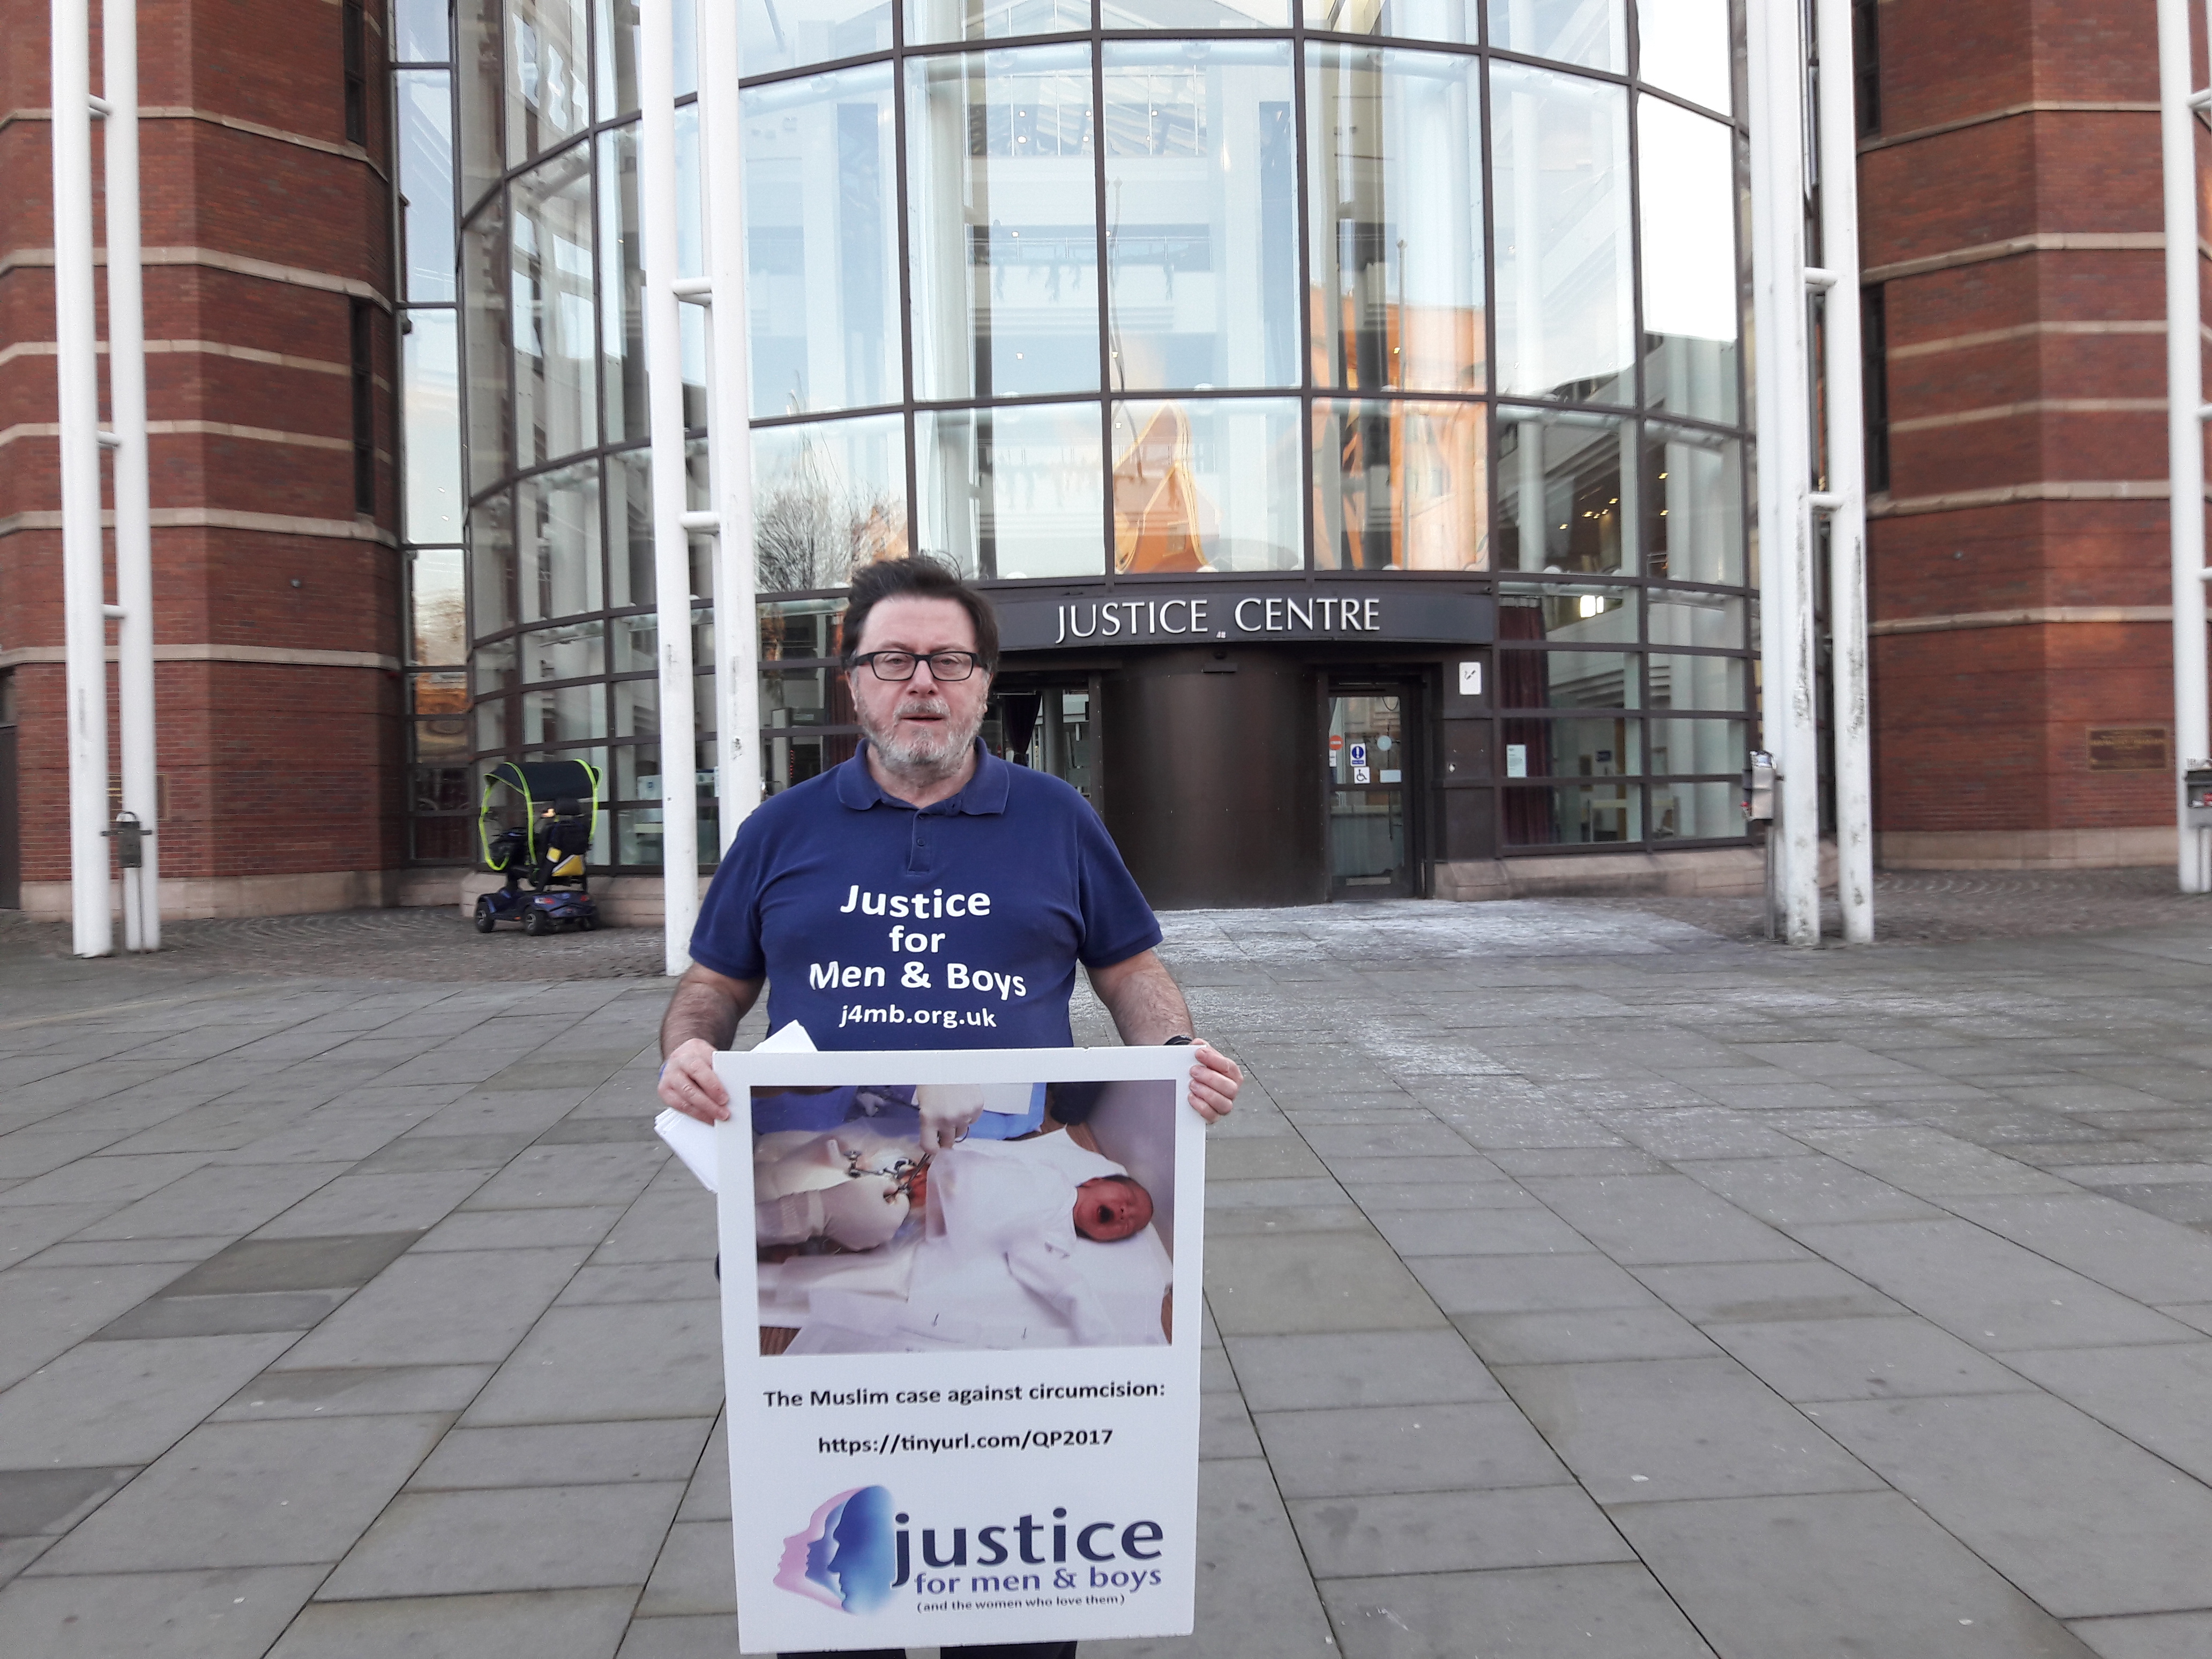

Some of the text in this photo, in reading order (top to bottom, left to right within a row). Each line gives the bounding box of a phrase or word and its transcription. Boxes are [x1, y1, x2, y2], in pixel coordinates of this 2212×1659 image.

[1055, 597, 1380, 644] JUSTICE CENTRE
[839, 885, 991, 919] Justice
[888, 925, 946, 953] for
[809, 961, 1027, 1001] Men & Boys
[839, 1004, 997, 1028] j4mb.org.uk
[763, 1381, 1165, 1407] The Muslim case against circumcision:
[818, 1429, 1114, 1456] https://tinyurl.com/QP2017
[892, 1507, 1163, 1588] justice
[915, 1565, 1162, 1595] for men & boys
[916, 1594, 1125, 1614] (and the women who love them)
